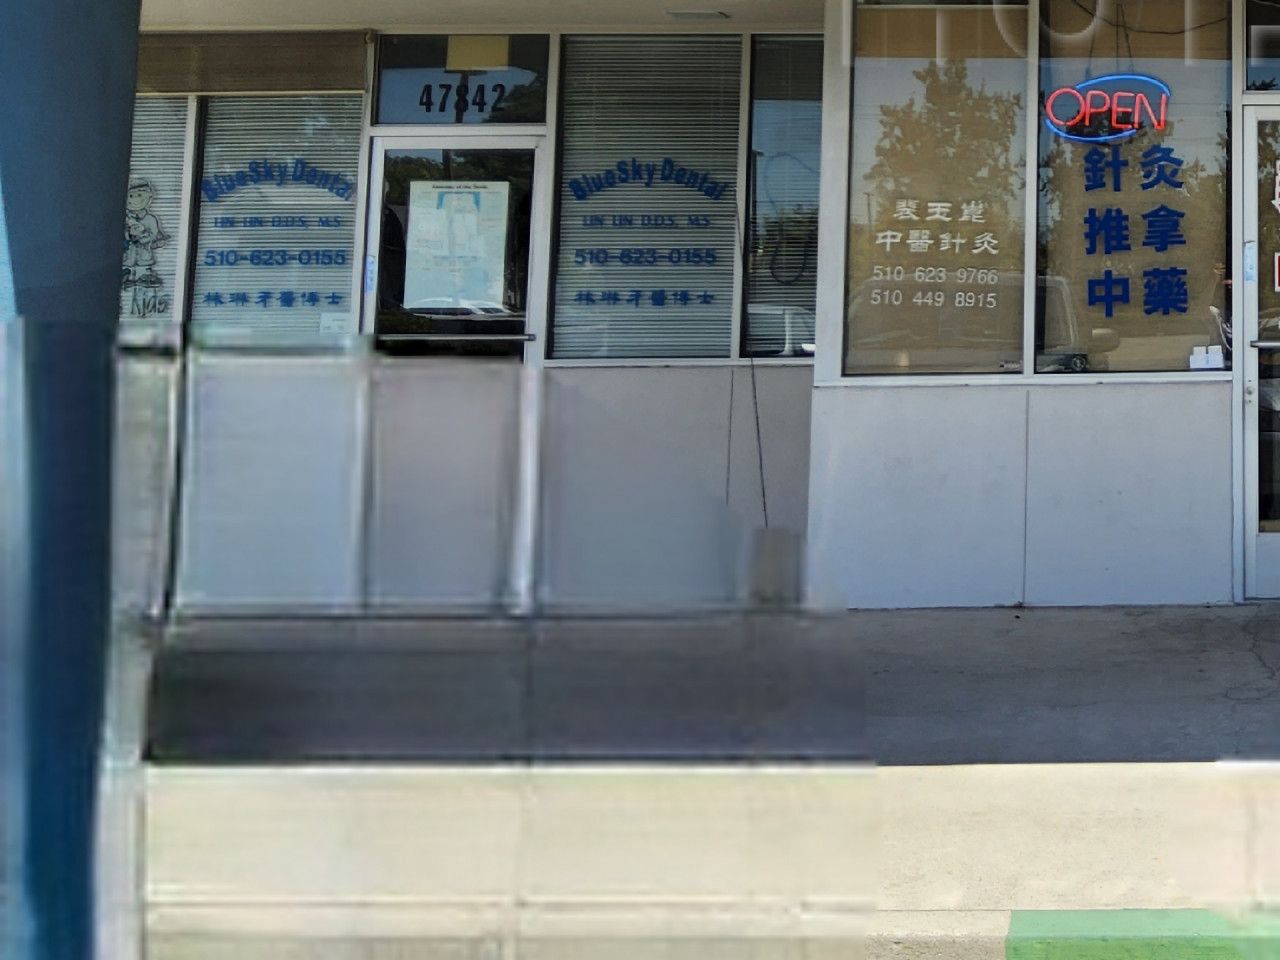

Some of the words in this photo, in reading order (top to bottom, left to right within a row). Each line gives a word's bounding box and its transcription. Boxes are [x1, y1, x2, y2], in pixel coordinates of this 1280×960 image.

[419, 84, 506, 113] 47842
[1046, 88, 1167, 129] OPEN
[1084, 144, 1184, 192] 針灸
[875, 230, 999, 254] 中醫針灸
[1084, 204, 1187, 254] 推拿
[204, 249, 346, 266] 510-623-0155
[574, 248, 717, 265] 510-623-0155
[873, 265, 904, 281] 510
[914, 267, 946, 282] 623
[956, 268, 998, 284] 9766
[870, 289, 902, 305] 510
[912, 291, 944, 306] 449
[954, 292, 997, 308] 8915
[1087, 267, 1188, 318] 中藥
